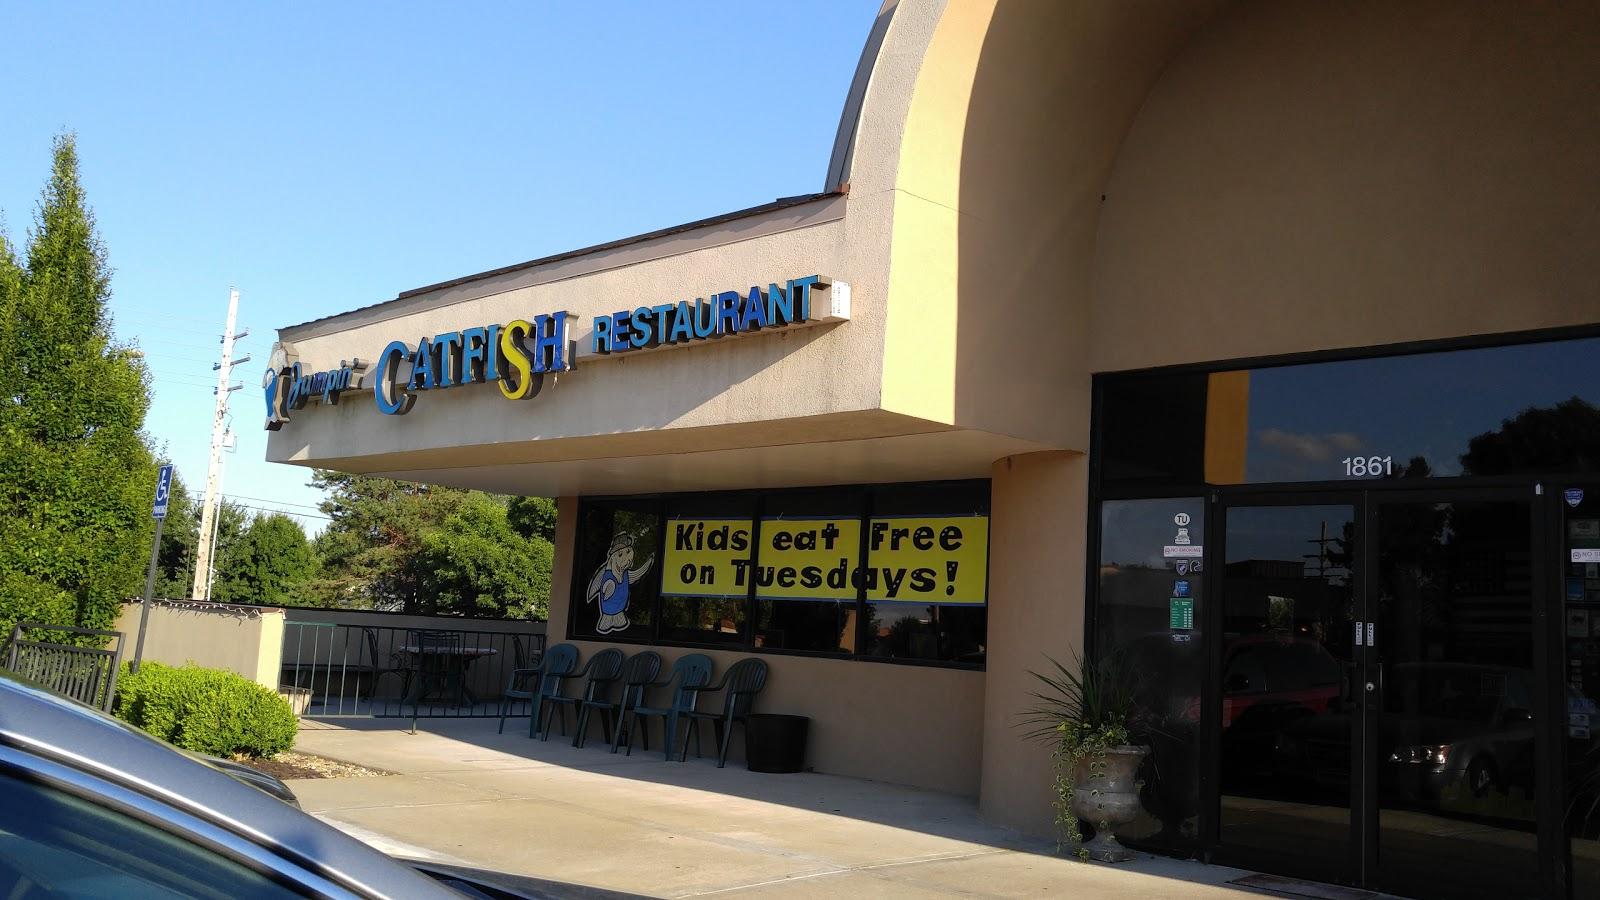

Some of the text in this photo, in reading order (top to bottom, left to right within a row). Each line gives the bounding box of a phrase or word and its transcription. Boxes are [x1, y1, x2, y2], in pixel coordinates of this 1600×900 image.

[374, 310, 568, 415] CATFISH
[592, 274, 818, 353] RESTAURANT
[1342, 455, 1391, 476] 1861
[675, 521, 963, 551] Kids eat Free
[680, 558, 959, 598] on Tuesdays!
